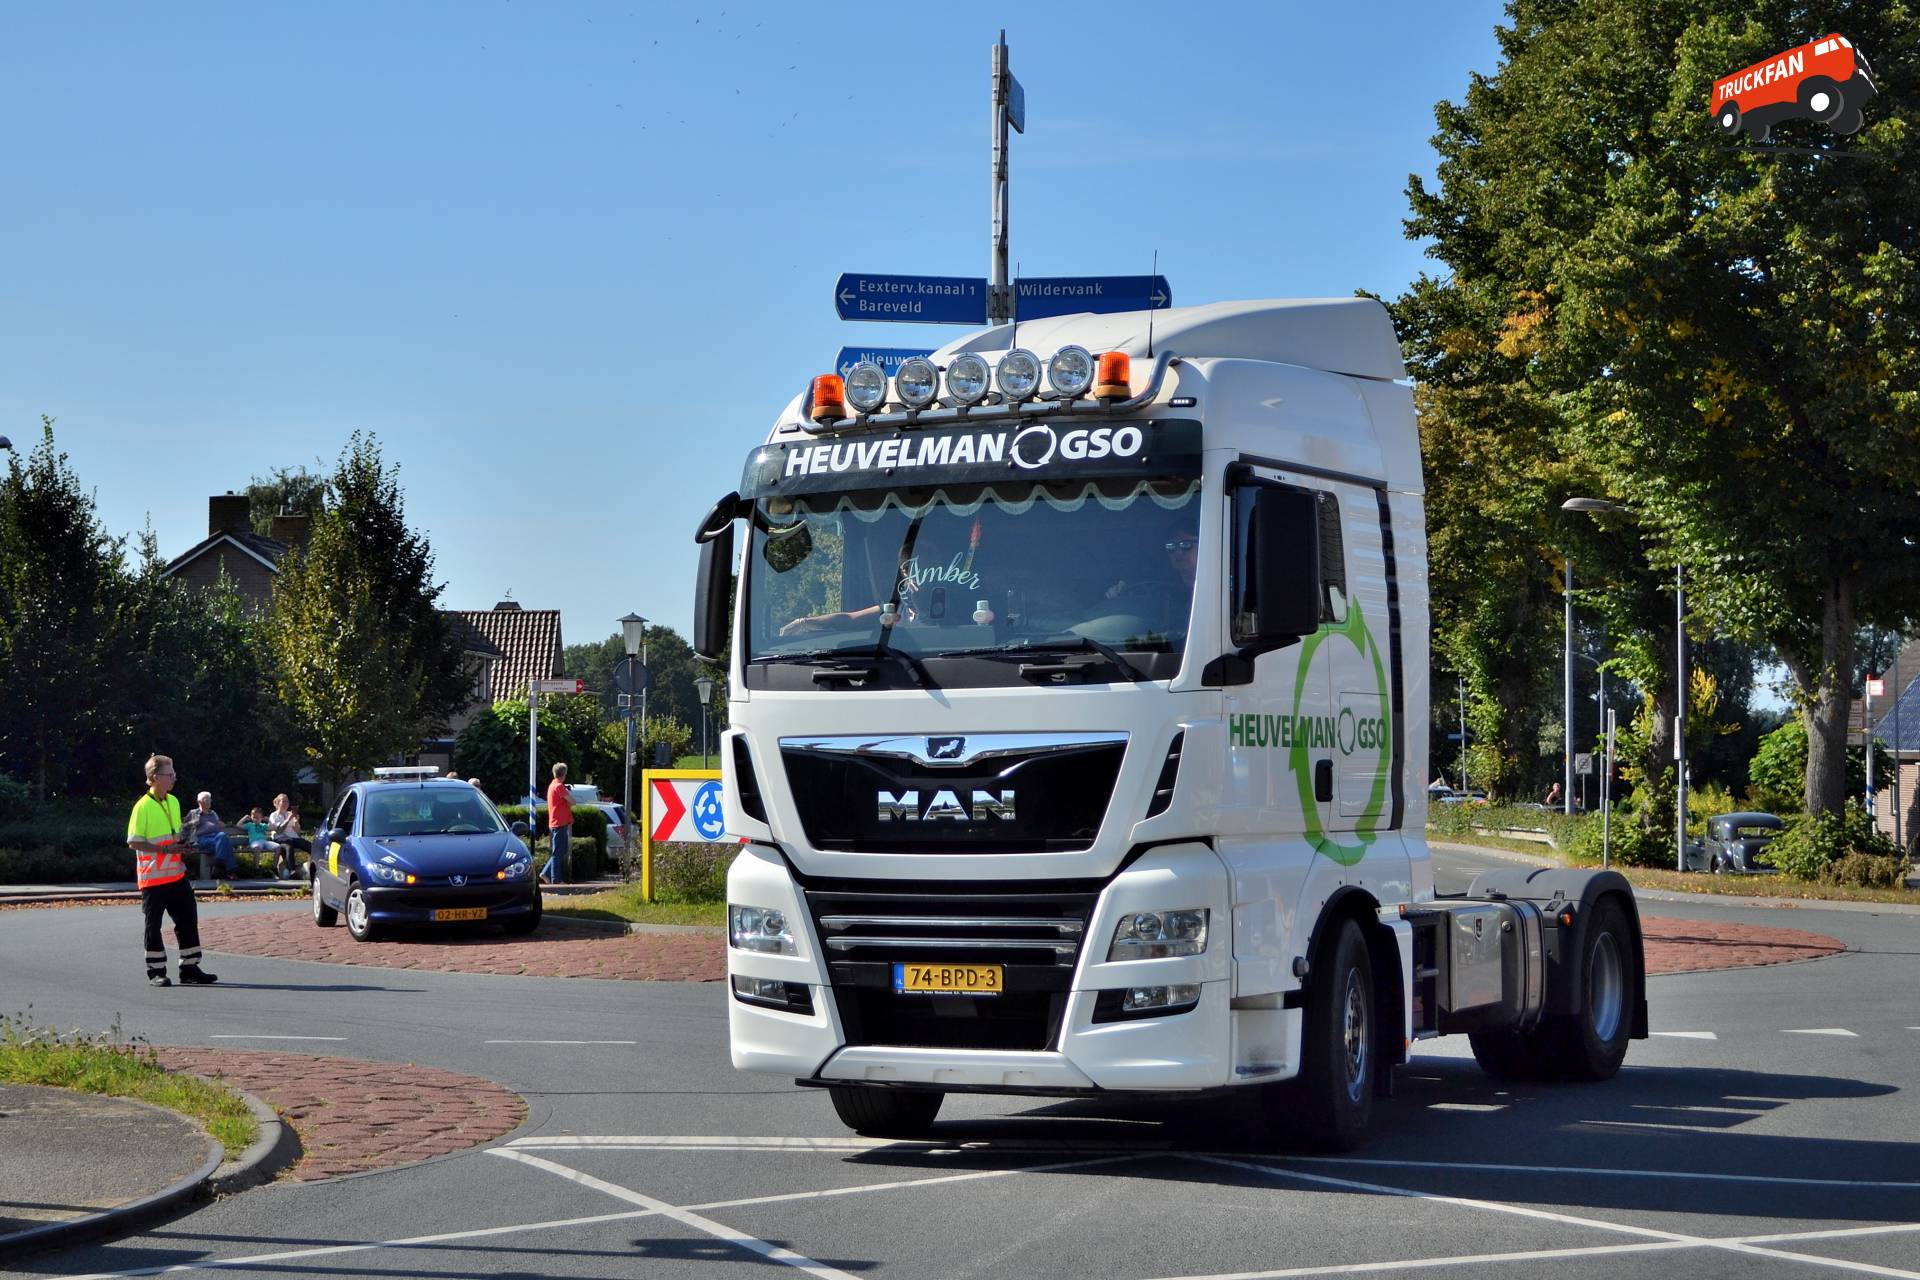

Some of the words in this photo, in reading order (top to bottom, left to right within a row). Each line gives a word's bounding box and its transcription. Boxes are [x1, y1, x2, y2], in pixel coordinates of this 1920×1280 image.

[859, 280, 965, 295] Eexterv.kanaal
[970, 286, 975, 295] 1
[1019, 283, 1103, 296] Wildervank
[859, 299, 922, 313] Bareveld
[785, 432, 1007, 476] HEUVELMAN
[1060, 426, 1143, 460] GSO
[897, 551, 980, 600] Amber
[1229, 713, 1336, 748] HEUVELMAN
[1357, 718, 1388, 749] GSO
[878, 790, 1016, 821] MAN
[911, 968, 996, 987] 74-BPD-3
